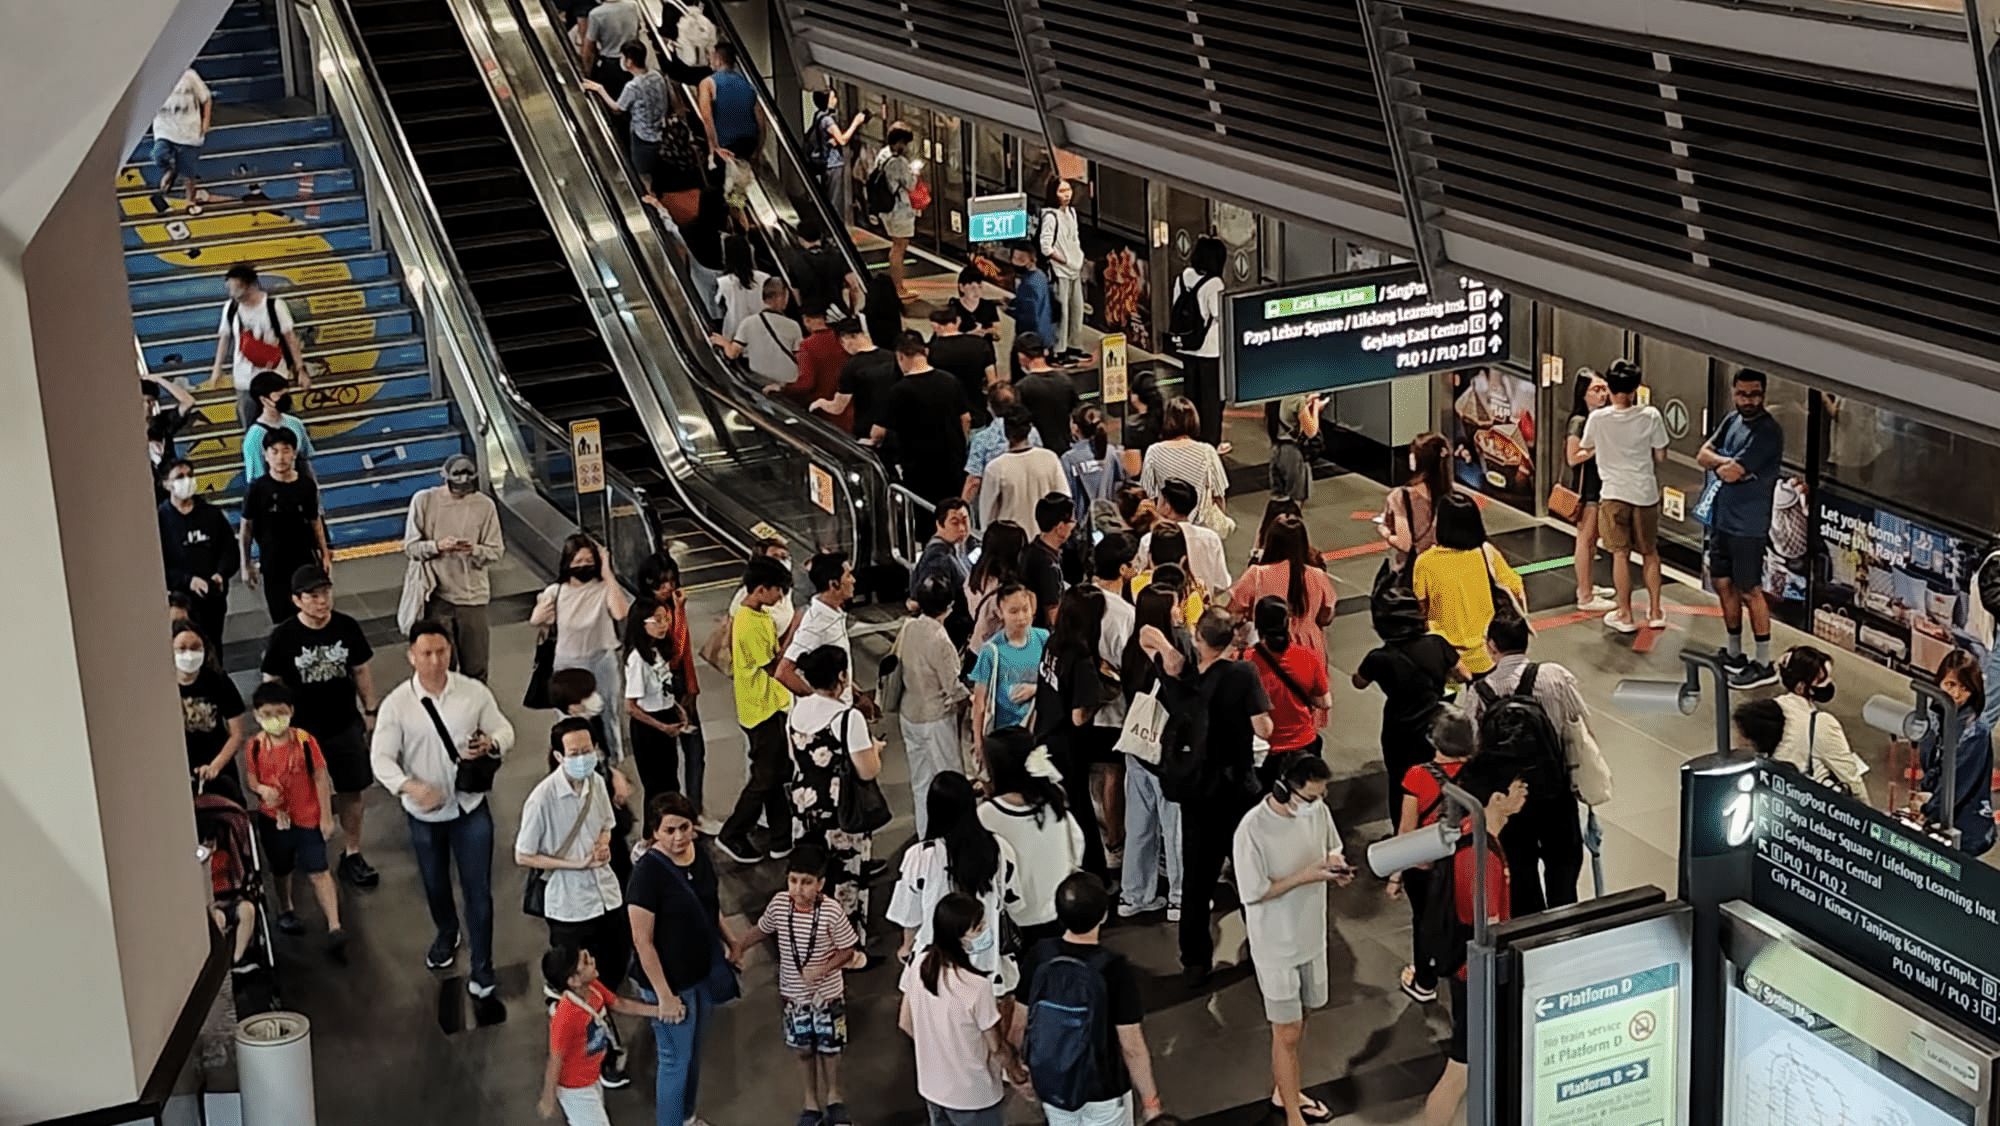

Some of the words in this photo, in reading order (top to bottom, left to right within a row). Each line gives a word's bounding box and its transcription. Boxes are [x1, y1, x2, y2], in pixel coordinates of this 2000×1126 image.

[983, 215, 1015, 235] EXIT
[1292, 298, 1314, 312] East
[1343, 291, 1365, 304] Line
[1243, 330, 1271, 346] Paya
[1271, 323, 1303, 342] Lebar
[1304, 318, 1344, 338] Square
[1351, 309, 1397, 329] Lifelong
[1397, 302, 1444, 322] Learning
[1444, 299, 1468, 314] Inst.
[1361, 332, 1407, 351] Geylang
[1406, 327, 1429, 343] East
[1430, 319, 1468, 340] Central
[1396, 350, 1420, 368] PLQ
[1420, 349, 1428, 364] 1
[1428, 347, 1436, 364] /
[1436, 344, 1459, 361] PLQ
[1458, 343, 1467, 358] 2
[1820, 504, 1839, 523] Let
[1840, 512, 1867, 531] your
[1868, 522, 1900, 547] home
[1820, 523, 1851, 545] shine
[1852, 531, 1874, 552] this
[1785, 782, 1826, 815] SingPost
[1828, 803, 1861, 830] Centre
[1861, 820, 1868, 835] /
[1890, 834, 1909, 853] East
[1909, 843, 1931, 864] West
[1932, 855, 1951, 873] Line
[1784, 830, 1822, 862] Geylang
[1824, 849, 1844, 870] East
[1846, 861, 1882, 890] Central
[1784, 806, 1807, 831] Paya
[1809, 818, 1837, 842] Lebar
[1838, 832, 1873, 861] Square
[1874, 851, 1881, 864] /
[1882, 854, 1923, 889] Lifelong
[1926, 876, 1973, 914] Learning
[1975, 901, 1999, 925] Inst.
[1784, 851, 1802, 873] PLQ
[1805, 862, 1810, 875] 1
[1812, 866, 1818, 880] /
[1819, 870, 1838, 893] PLQ
[1840, 881, 1848, 895] 2
[1770, 868, 1789, 890] City
[1791, 878, 1816, 902] Plaza
[1817, 892, 1823, 906] /
[1825, 896, 1852, 922] Kinex
[1853, 911, 1860, 925] /
[1860, 915, 1902, 951] Tanjong
[1903, 938, 1941, 972] Katong
[1943, 960, 1980, 990] Cmplx.
[1559, 985, 1618, 1010] Platform
[1621, 978, 1632, 994] D
[1892, 956, 1914, 980] PLQ
[1916, 968, 1938, 992] Mall
[1940, 982, 1947, 996] /
[1948, 986, 1970, 1011] PLQ
[1971, 999, 1979, 1014] 3
[1560, 1030, 1584, 1044] train
[1587, 1022, 1622, 1037] service
[1544, 1054, 1555, 1066] at
[1559, 1040, 1610, 1062] Platform
[1614, 1035, 1623, 1047] D
[1561, 1075, 1611, 1098] Platform
